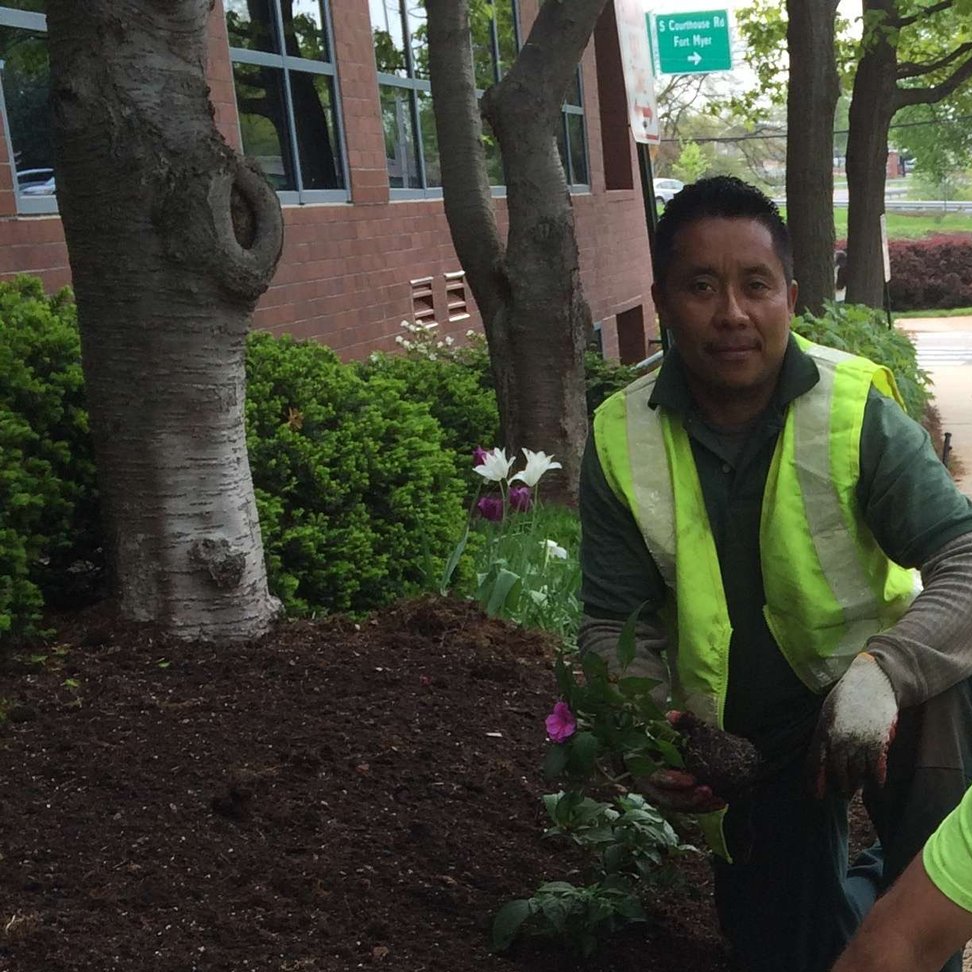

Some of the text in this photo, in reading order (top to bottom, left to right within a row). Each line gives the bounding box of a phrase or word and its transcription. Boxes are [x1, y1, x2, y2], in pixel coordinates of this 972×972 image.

[659, 16, 725, 32] S Courthouse Rd
[673, 34, 712, 48] Fort Myer
